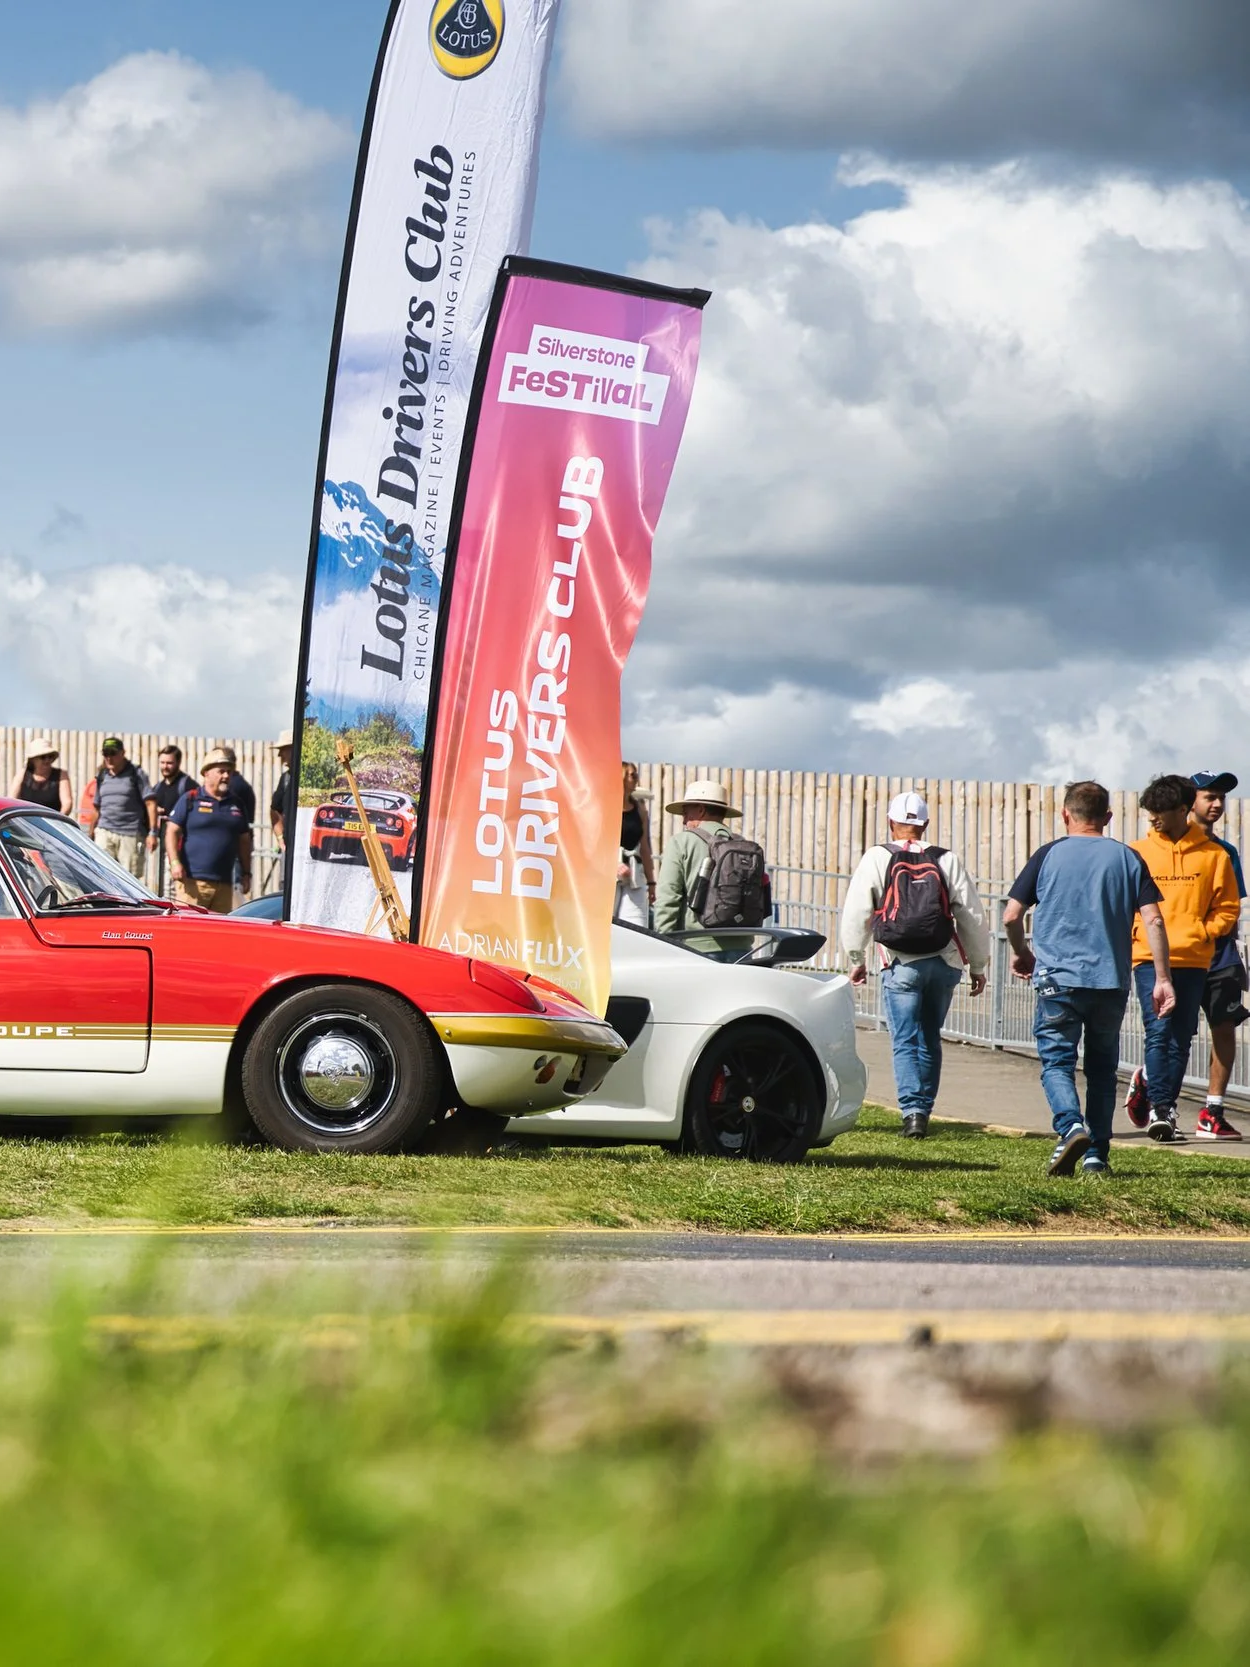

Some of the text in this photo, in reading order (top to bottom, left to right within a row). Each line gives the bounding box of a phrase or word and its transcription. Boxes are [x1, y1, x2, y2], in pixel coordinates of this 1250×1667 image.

[439, 23, 492, 49] LOTUS
[448, 151, 477, 281] ADVENTURES
[438, 290, 458, 371] DRIVING
[537, 336, 636, 369] Silverstone
[360, 144, 454, 681] Lotus Drivers Club
[430, 394, 446, 465] EVENTS
[420, 487, 439, 588] MAGAZINE
[413, 596, 432, 680] CHICANE
[511, 455, 605, 900] DRIVERS CLUB
[471, 688, 519, 896] LOTUS
[438, 932, 584, 970] ADRIAN FLUX
